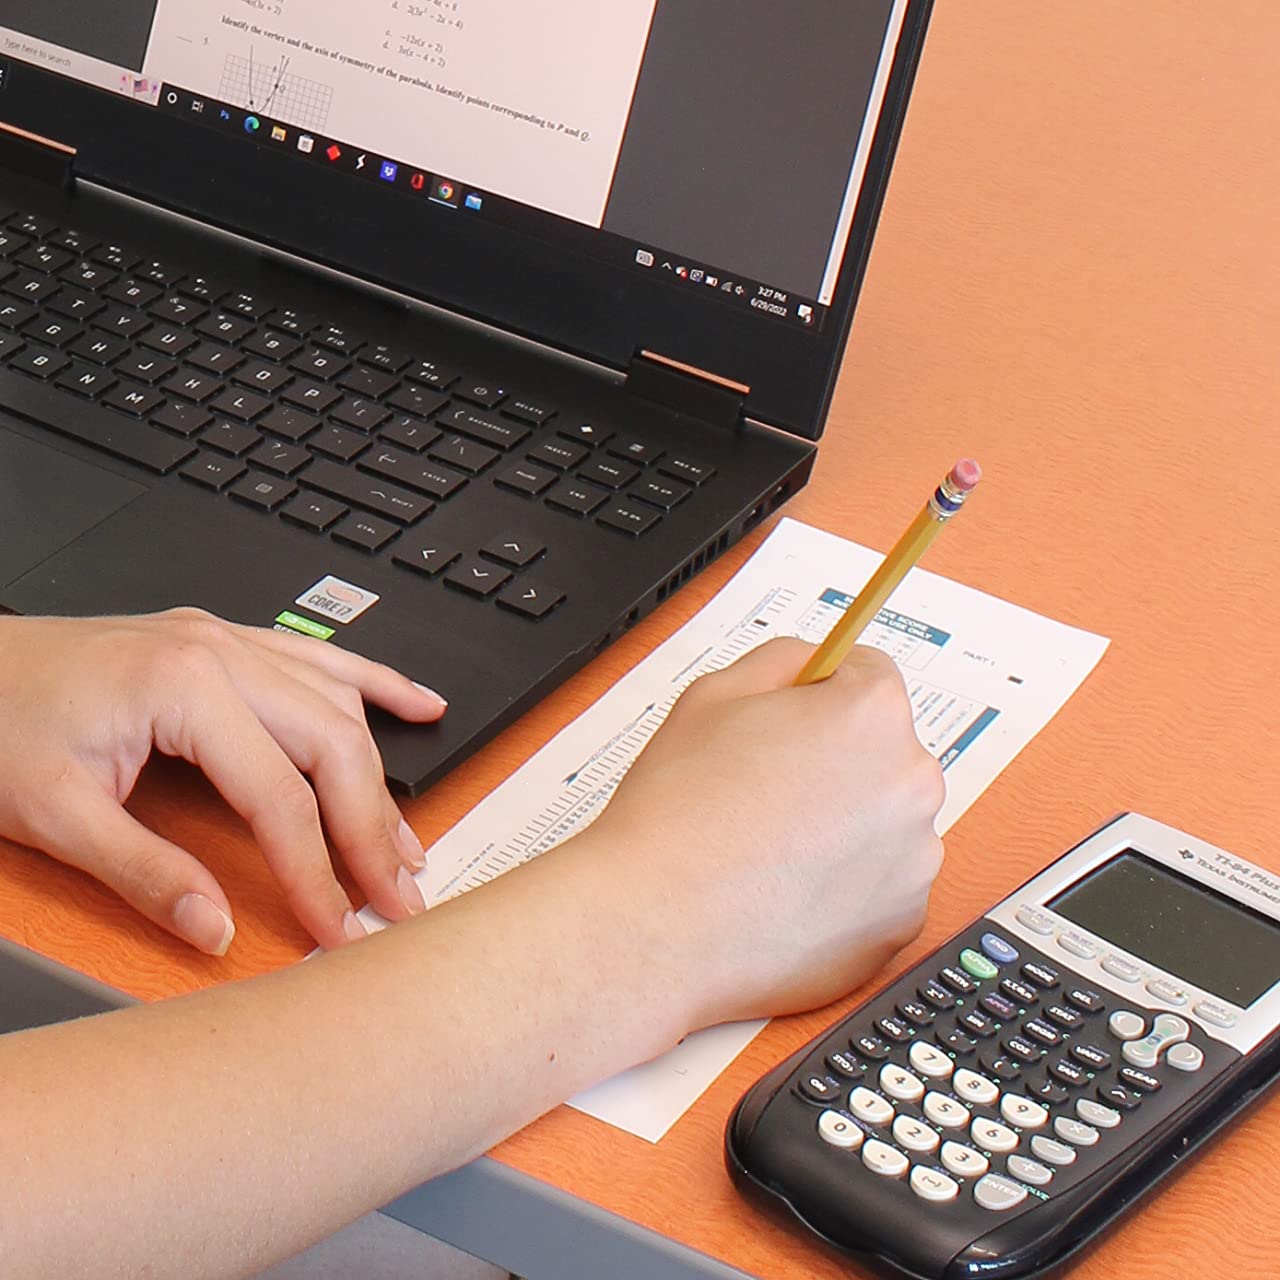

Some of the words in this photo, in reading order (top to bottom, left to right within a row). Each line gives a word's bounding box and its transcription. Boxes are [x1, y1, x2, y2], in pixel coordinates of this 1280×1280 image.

[221, 15, 249, 32] Identify
[249, 24, 262, 36] the
[262, 28, 285, 43] vertex
[286, 36, 300, 48] and
[301, 41, 313, 53] the
[314, 45, 329, 57] axis
[329, 50, 338, 61] of
[338, 53, 375, 72] symmetry
[375, 64, 385, 75] of
[385, 68, 398, 80] the
[398, 72, 435, 92] parabola.
[435, 84, 466, 102] Identify
[466, 94, 490, 109] points
[490, 101, 546, 128] corresponding
[546, 119, 555, 131] to
[555, 122, 564, 133] P
[564, 125, 579, 138] and
[580, 130, 591, 142] Q.
[25, 282, 39, 291] R
[758, 285, 773, 297] 3:27
[773, 291, 787, 303] PM
[72, 300, 84, 308] T
[1, 307, 16, 315] F
[118, 317, 130, 325] Y
[46, 326, 60, 335] G
[162, 334, 176, 343] U
[92, 343, 107, 353] H
[33, 356, 48, 365] B
[138, 362, 153, 371] J
[80, 375, 95, 384] N
[125, 393, 143, 403] M
[305, 389, 319, 397] P
[234, 398, 243, 408] L
[308, 595, 338, 613] CORE
[889, 620, 907, 630] USE
[908, 627, 932, 639] ONLY
[963, 650, 989, 662] PART
[1197, 857, 1226, 876] TEXAS
[1215, 853, 1250, 874] TI-84
[1025, 963, 1054, 982] MODE
[942, 968, 969, 988] MATH
[1072, 991, 1092, 1005] DEL
[923, 1052, 936, 1062] 7
[894, 1075, 906, 1085] 4
[1122, 1068, 1158, 1085] CLEAR
[810, 1077, 827, 1092] ON
[968, 1080, 980, 1089] 8
[865, 1100, 875, 1108] 1
[937, 1103, 952, 1112] 5
[1018, 1104, 1028, 1113] 9
[834, 1122, 847, 1132] 0
[907, 1127, 920, 1138] 2
[986, 1129, 999, 1138] 6
[955, 1152, 969, 1162] 3
[983, 1179, 1019, 1197] ENTER
[1020, 1184, 1050, 1201] SOLVE
